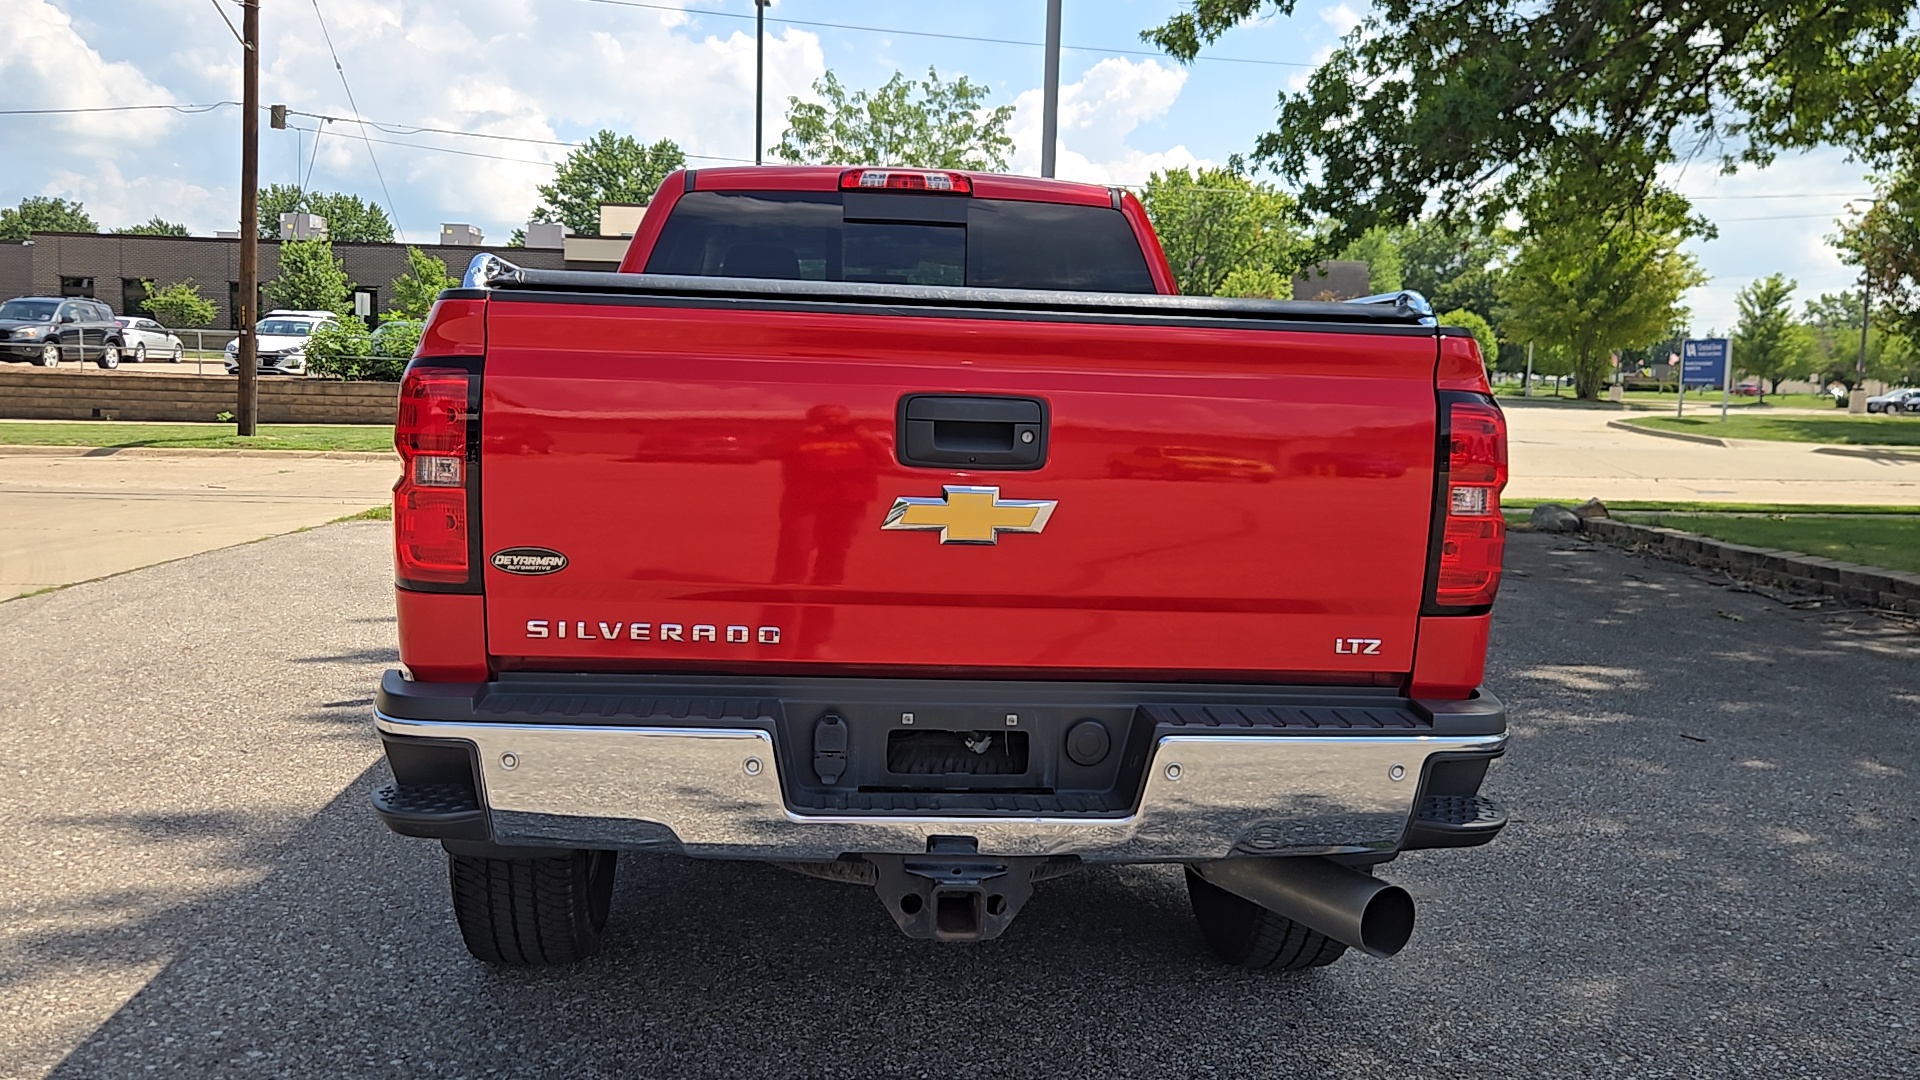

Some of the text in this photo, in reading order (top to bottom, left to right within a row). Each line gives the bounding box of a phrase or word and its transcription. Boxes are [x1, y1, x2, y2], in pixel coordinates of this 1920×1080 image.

[494, 555, 564, 566] DEYARMAN
[526, 620, 781, 644] SILVERADO
[1335, 638, 1382, 655] LTZ
